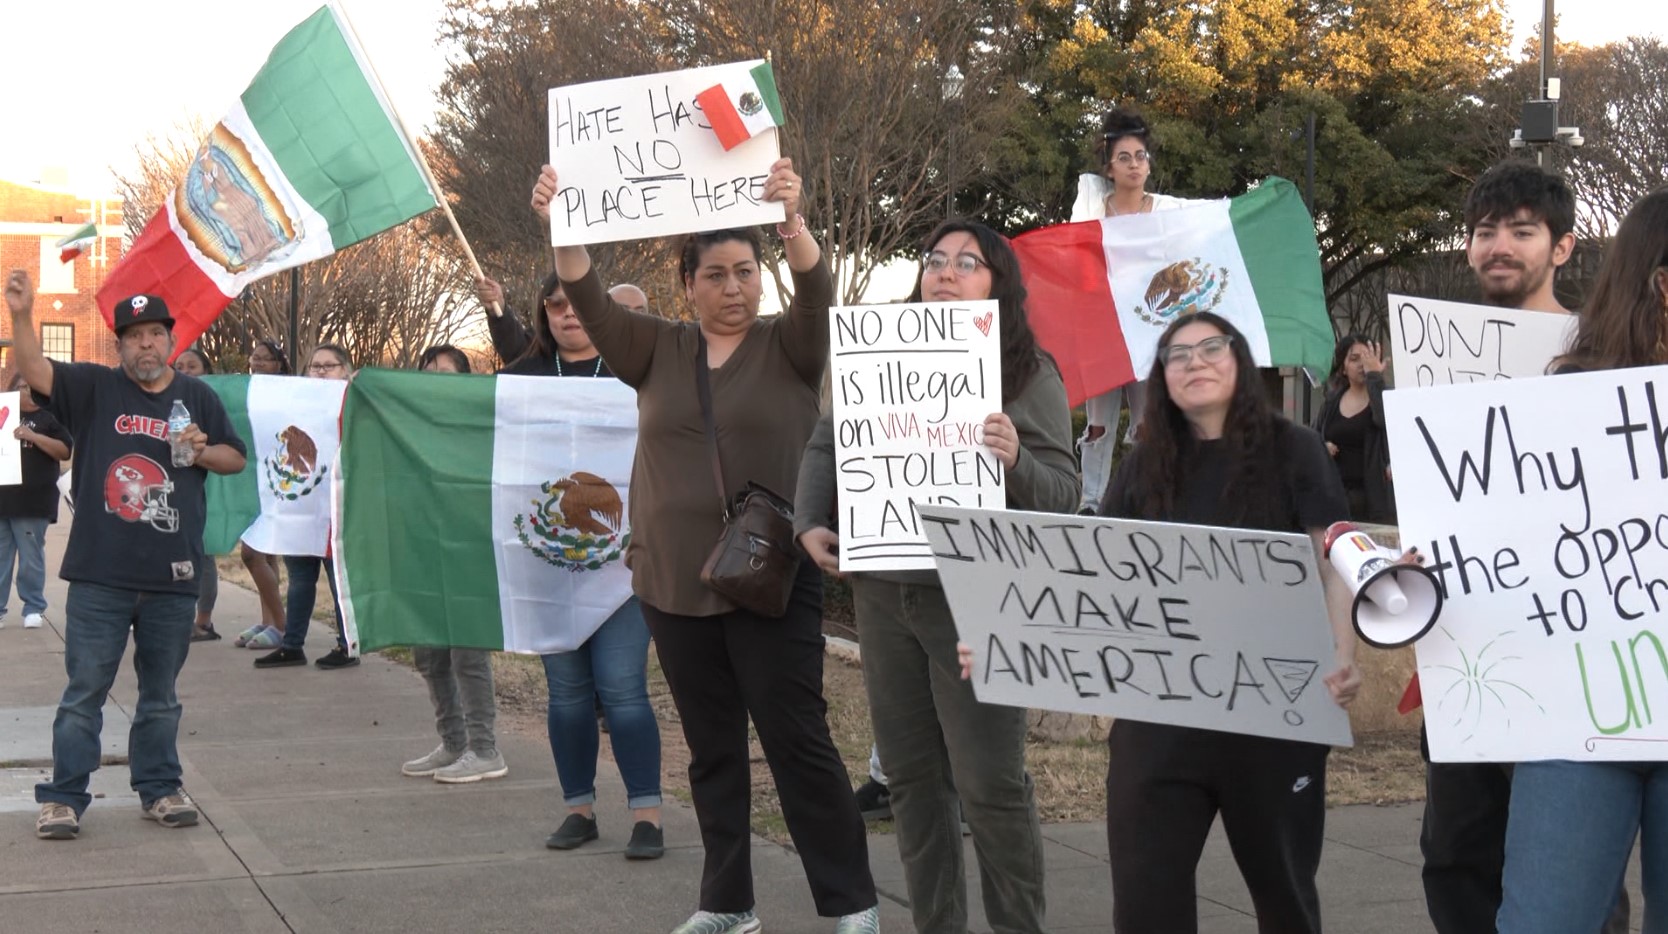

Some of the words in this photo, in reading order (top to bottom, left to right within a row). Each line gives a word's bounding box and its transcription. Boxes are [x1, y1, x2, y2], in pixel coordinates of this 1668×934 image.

[555, 96, 624, 148] HATE
[613, 139, 682, 175] NO
[557, 185, 664, 228] PLACE
[690, 174, 769, 216] HERE
[836, 310, 883, 347] NO
[897, 307, 971, 343] ONE
[839, 367, 864, 406] is
[876, 357, 985, 424] illegal
[839, 418, 875, 449] on
[878, 412, 921, 440] VIVA
[926, 421, 986, 448] MEXIC
[840, 450, 1001, 492] STOLEN
[1414, 403, 1591, 537] Why
[921, 513, 1308, 588] IMMIGRANTS
[1424, 534, 1530, 600] the
[1000, 581, 1201, 641] MAKE
[1526, 588, 1588, 637] to
